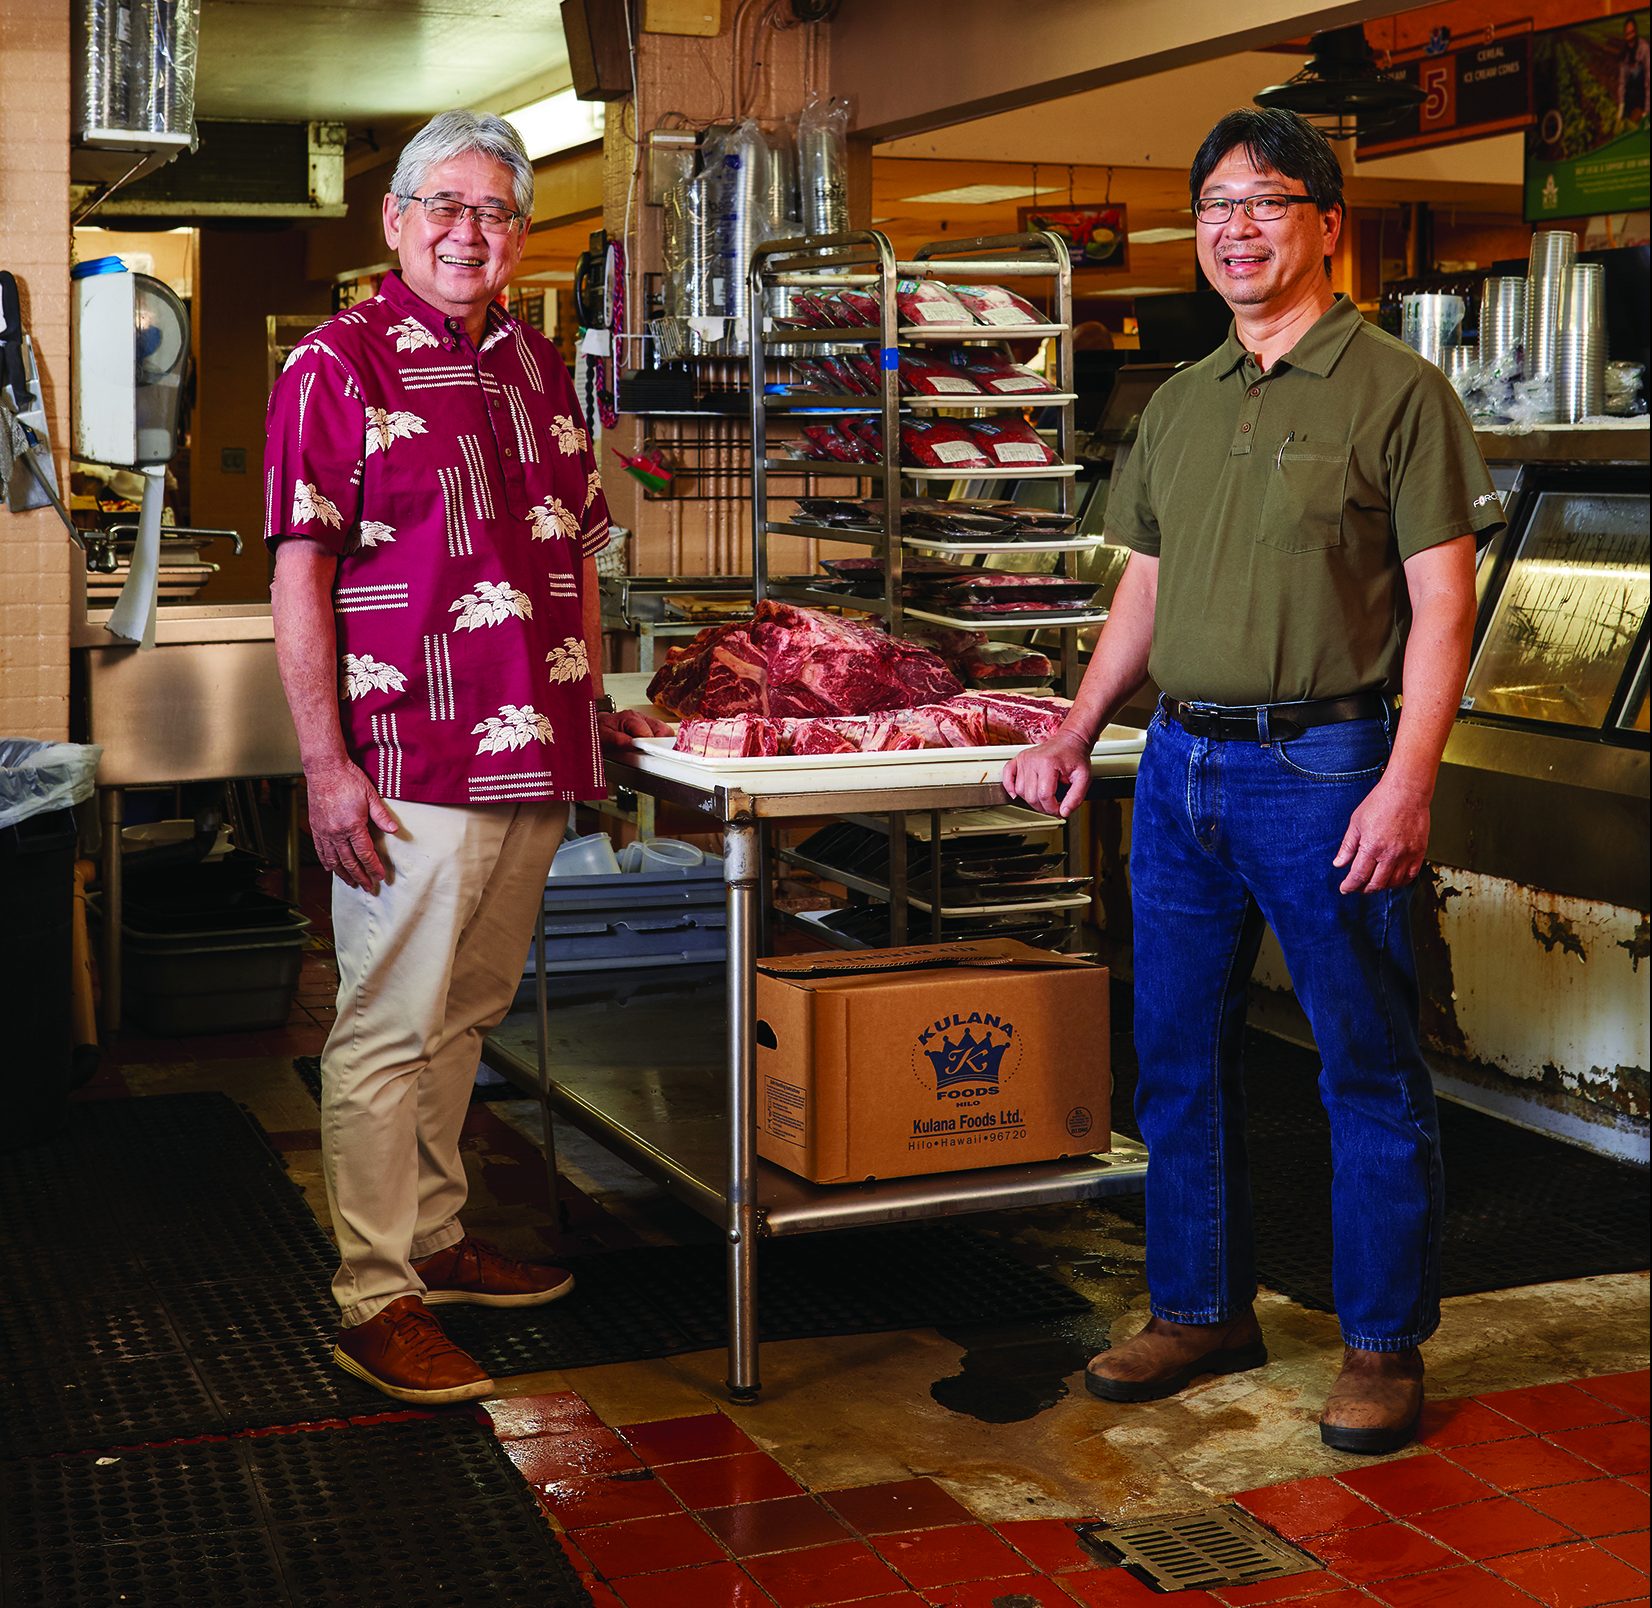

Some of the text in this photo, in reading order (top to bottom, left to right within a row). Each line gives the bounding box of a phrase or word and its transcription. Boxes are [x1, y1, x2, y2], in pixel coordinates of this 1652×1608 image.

[1426, 68, 1448, 119] 5
[917, 1011, 1014, 1046] KULANA
[944, 1046, 989, 1075] K
[936, 1086, 1000, 1101] FOODS
[956, 1100, 981, 1108] HILO
[913, 1109, 1024, 1135] Kulana Foods Ltd.
